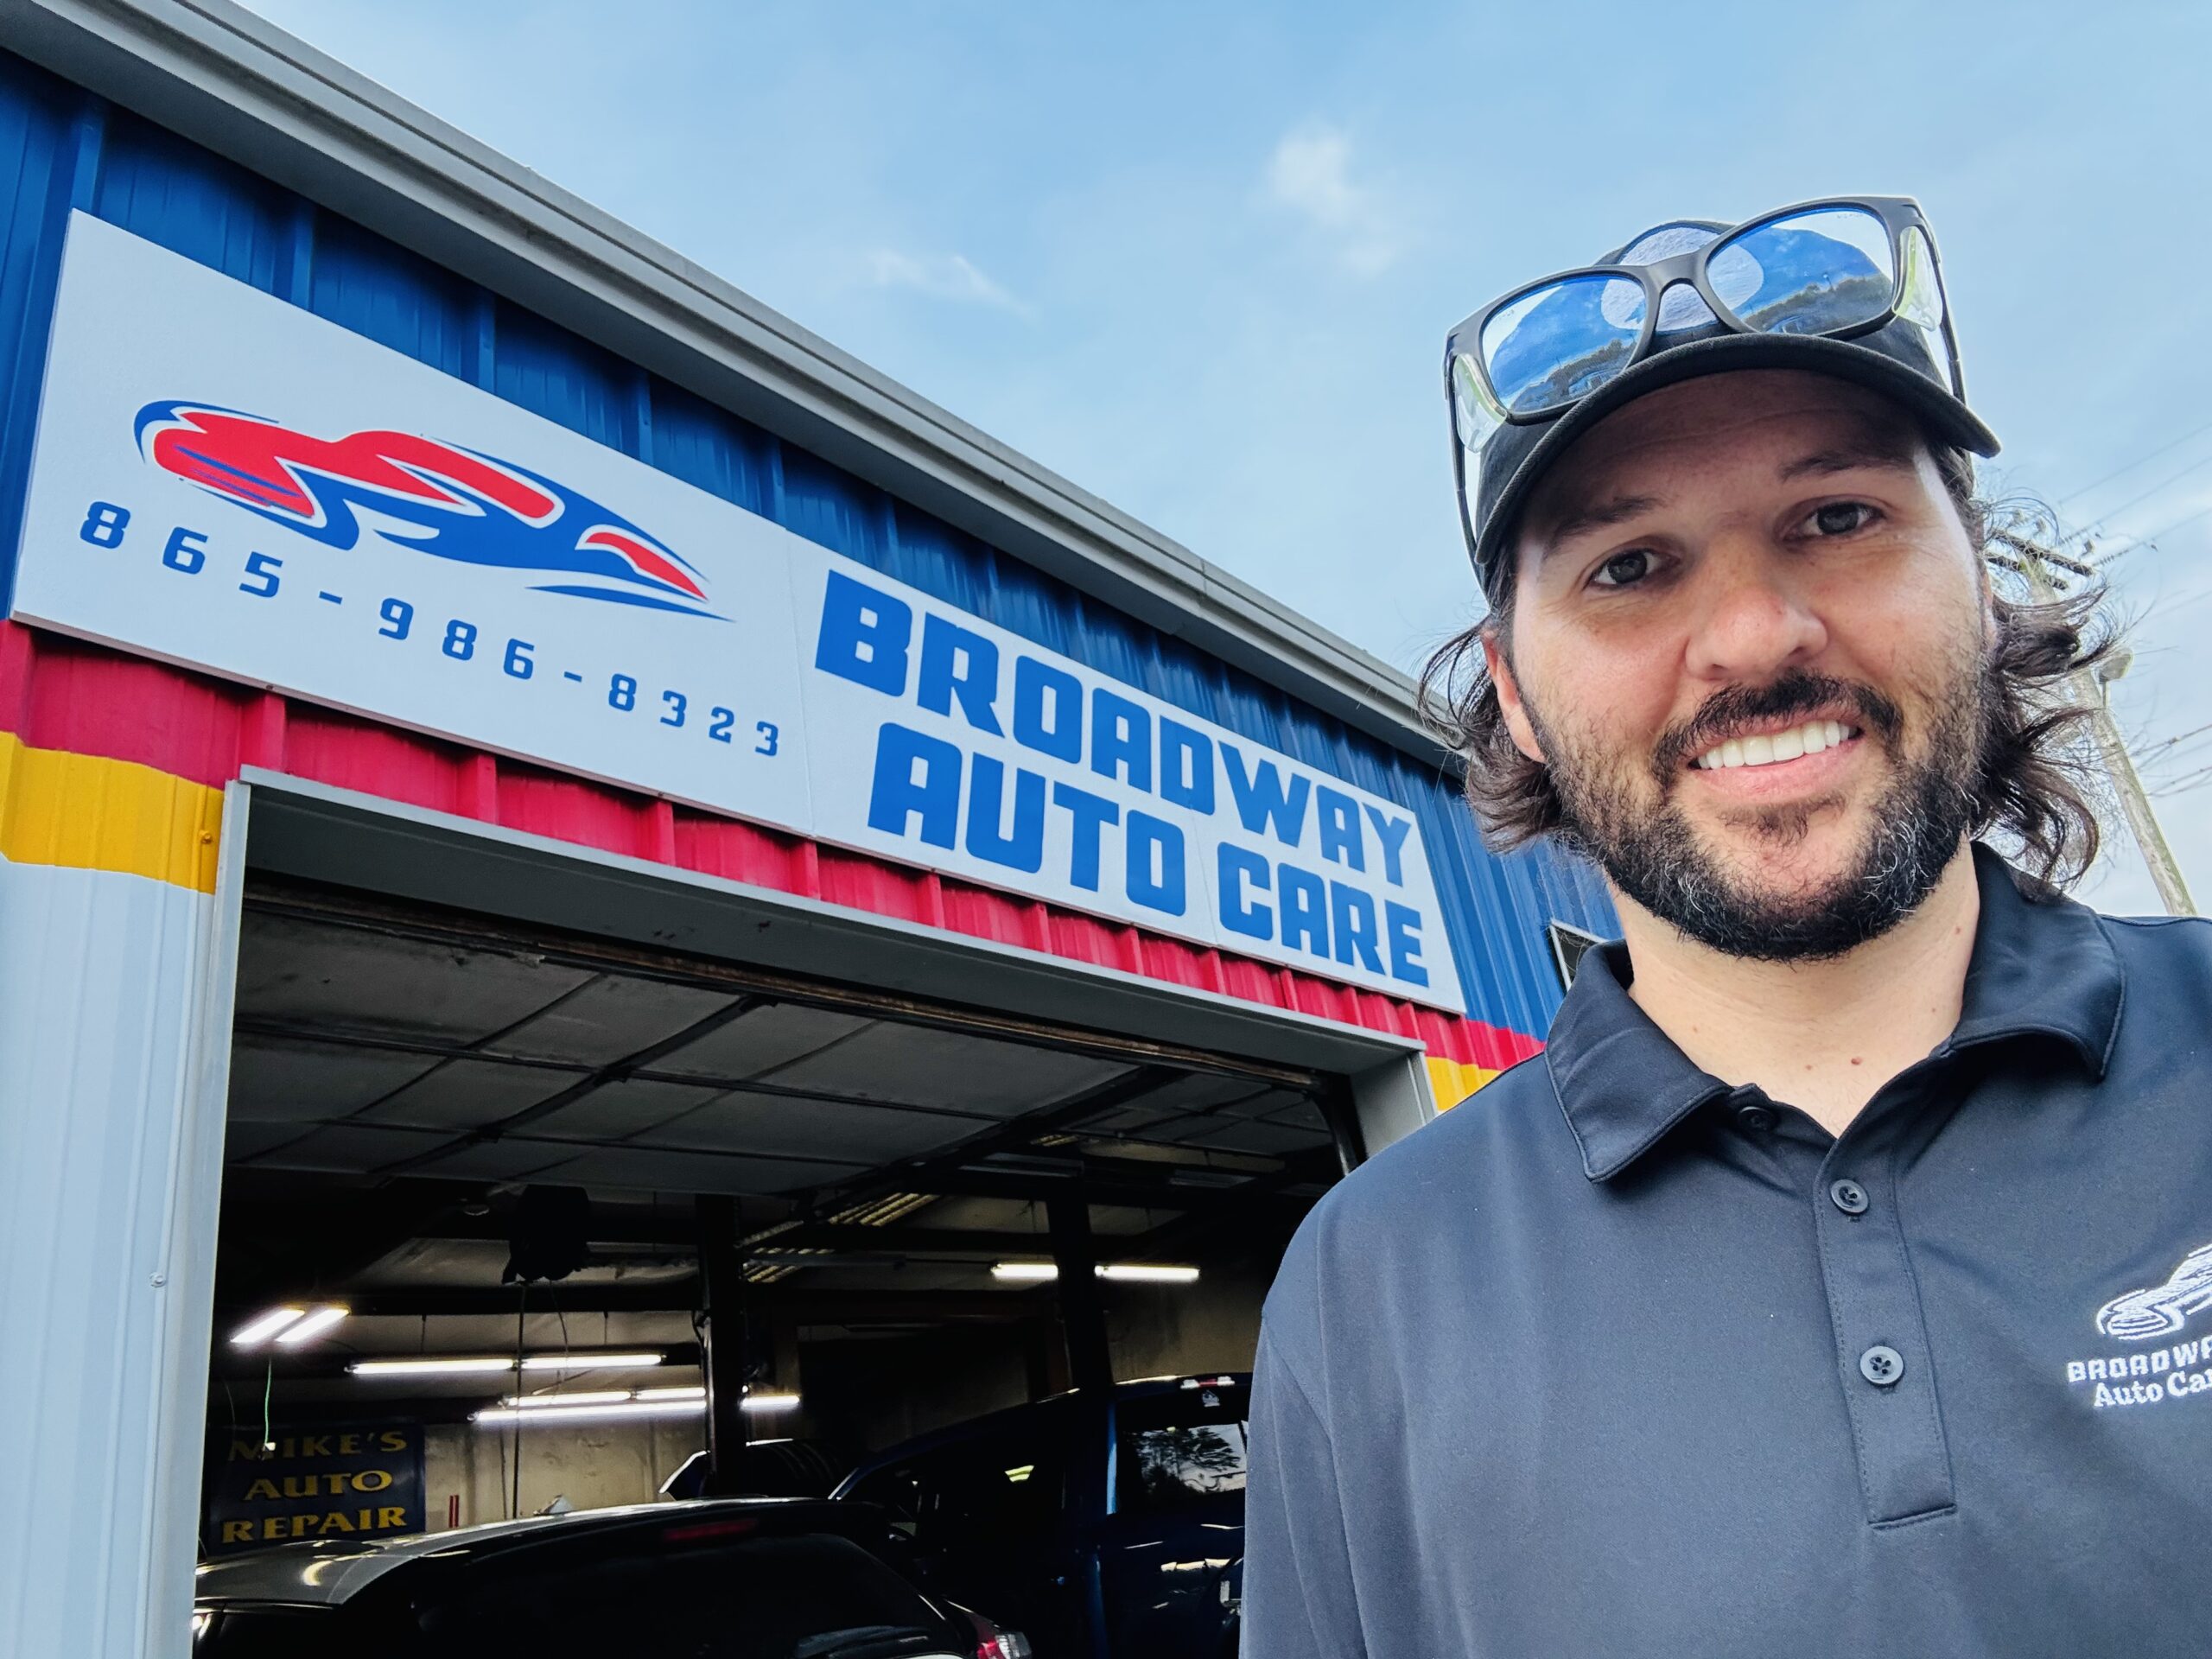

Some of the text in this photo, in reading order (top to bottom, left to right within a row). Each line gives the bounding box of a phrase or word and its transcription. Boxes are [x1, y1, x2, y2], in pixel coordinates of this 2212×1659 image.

[79, 499, 780, 759] 865-986-8323
[814, 568, 1412, 887] BROADWAY
[867, 721, 1430, 989] AUTO CARE
[2094, 1381, 2164, 1407] Auto
[227, 1431, 408, 1461] MIKE'S
[242, 1470, 393, 1501] AUTO
[221, 1506, 408, 1544] REPAIR
